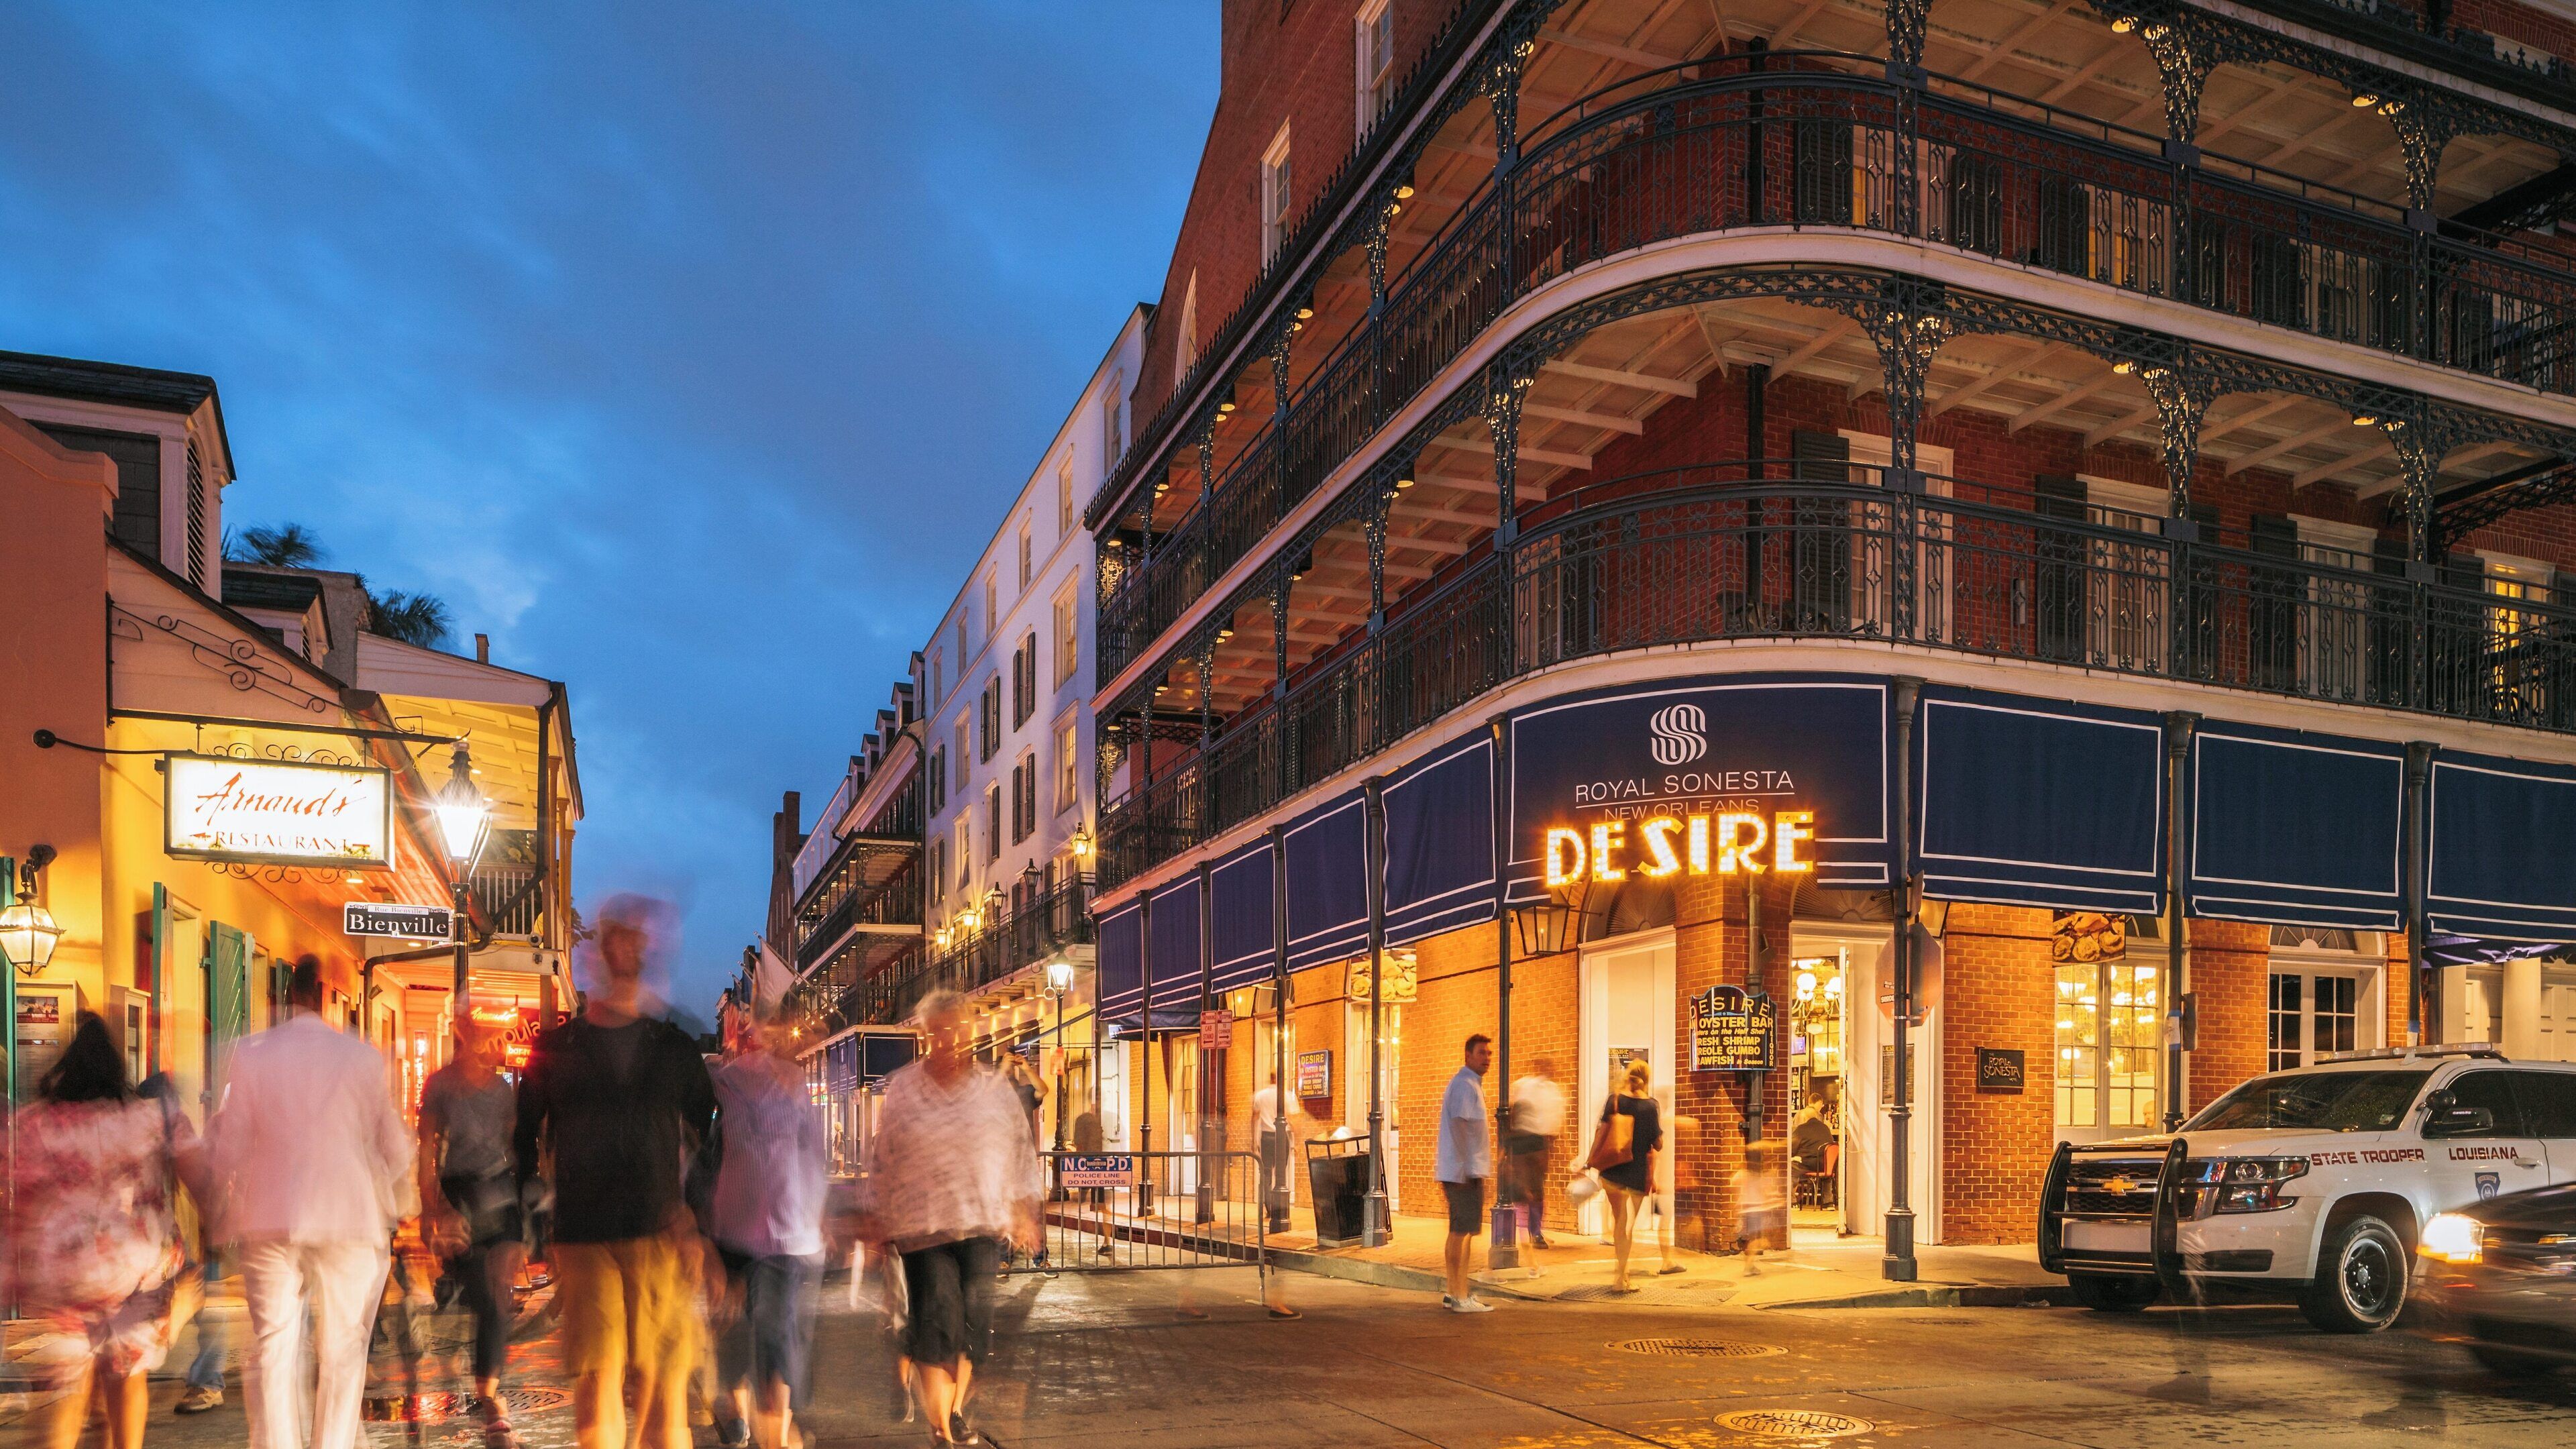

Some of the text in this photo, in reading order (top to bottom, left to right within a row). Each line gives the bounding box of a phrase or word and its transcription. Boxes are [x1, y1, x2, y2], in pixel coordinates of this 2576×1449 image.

[1576, 771, 1794, 802] ROYAL SONESTA
[196, 771, 367, 826] Arnaud's
[1605, 799, 1760, 822] NEW ORLEANS
[215, 831, 347, 852] RESTAURANT
[1546, 812, 1813, 887] DESIRE
[349, 914, 447, 934] Bienville
[1690, 996, 1770, 1019] DESIRE
[1699, 1017, 1746, 1029] OYSTER
[1751, 1017, 1773, 1028] BAR
[1697, 1046, 1761, 1055] REOLE GUMBO
[1723, 1036, 1760, 1045] SHRIMP
[1301, 1054, 1324, 1065] DESIRE
[1984, 1065, 2021, 1079] SONESTA
[1106, 1158, 1130, 1171] P.D.
[2311, 1146, 2520, 1166] STATE TROOPER LOUISIANA
